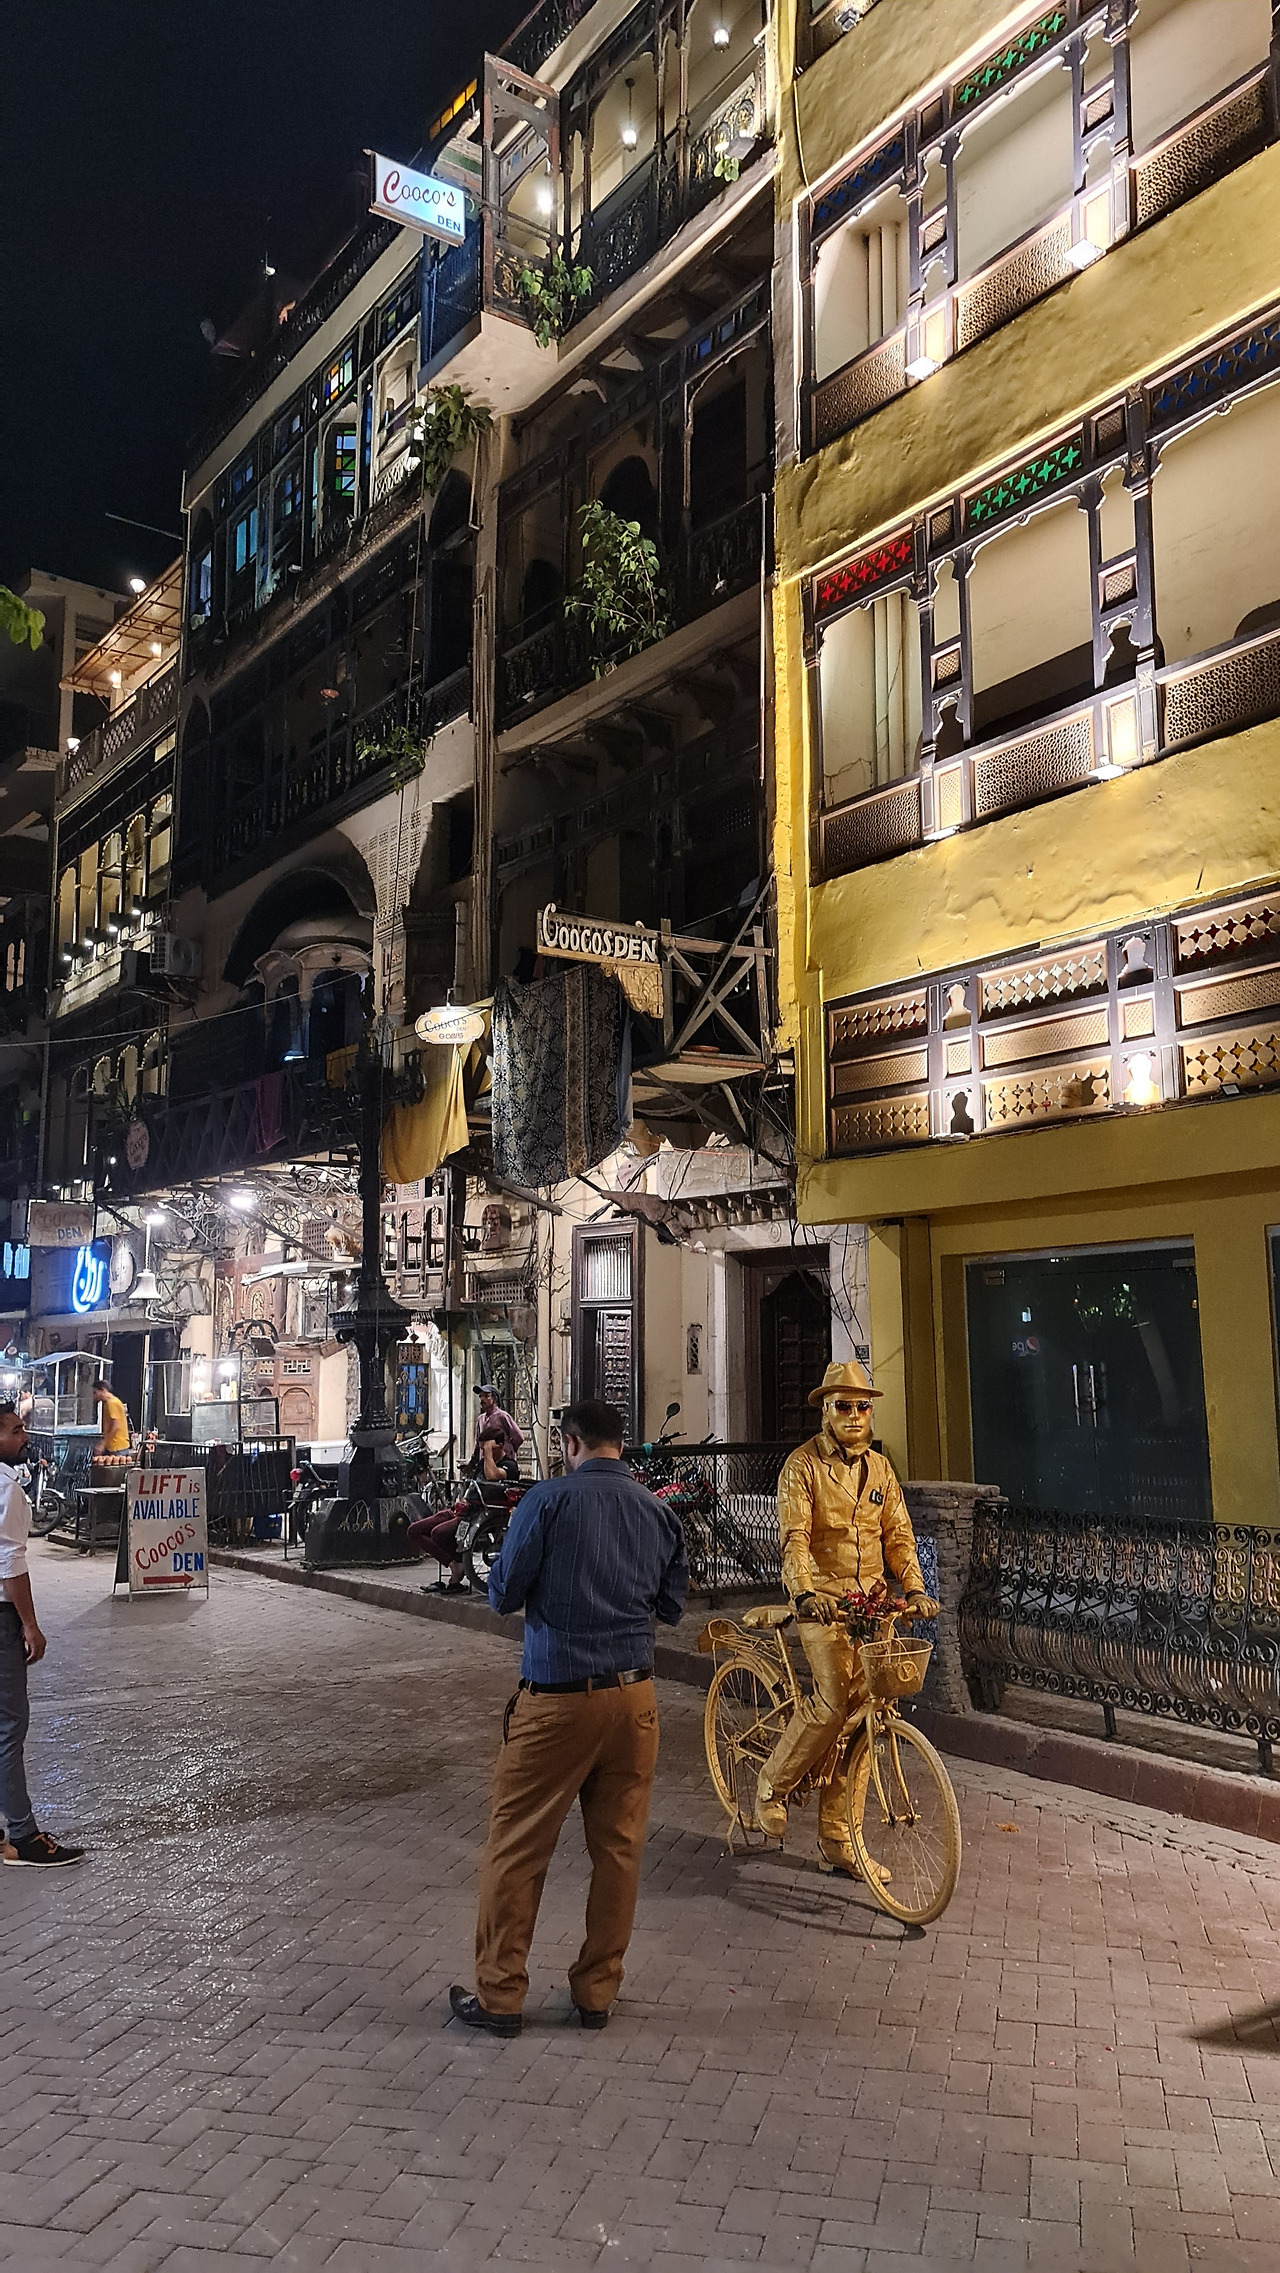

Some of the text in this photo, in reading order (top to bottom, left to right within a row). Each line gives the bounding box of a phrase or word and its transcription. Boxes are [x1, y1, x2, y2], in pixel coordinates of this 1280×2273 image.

[382, 170, 457, 207] Cooco's
[437, 214, 461, 232] DEN
[613, 935, 659, 963] DEN
[57, 1226, 82, 1240] DEN
[138, 1474, 200, 1495] LIFT is
[132, 1498, 200, 1520] AVAILABLE
[173, 1552, 204, 1572] DEN
